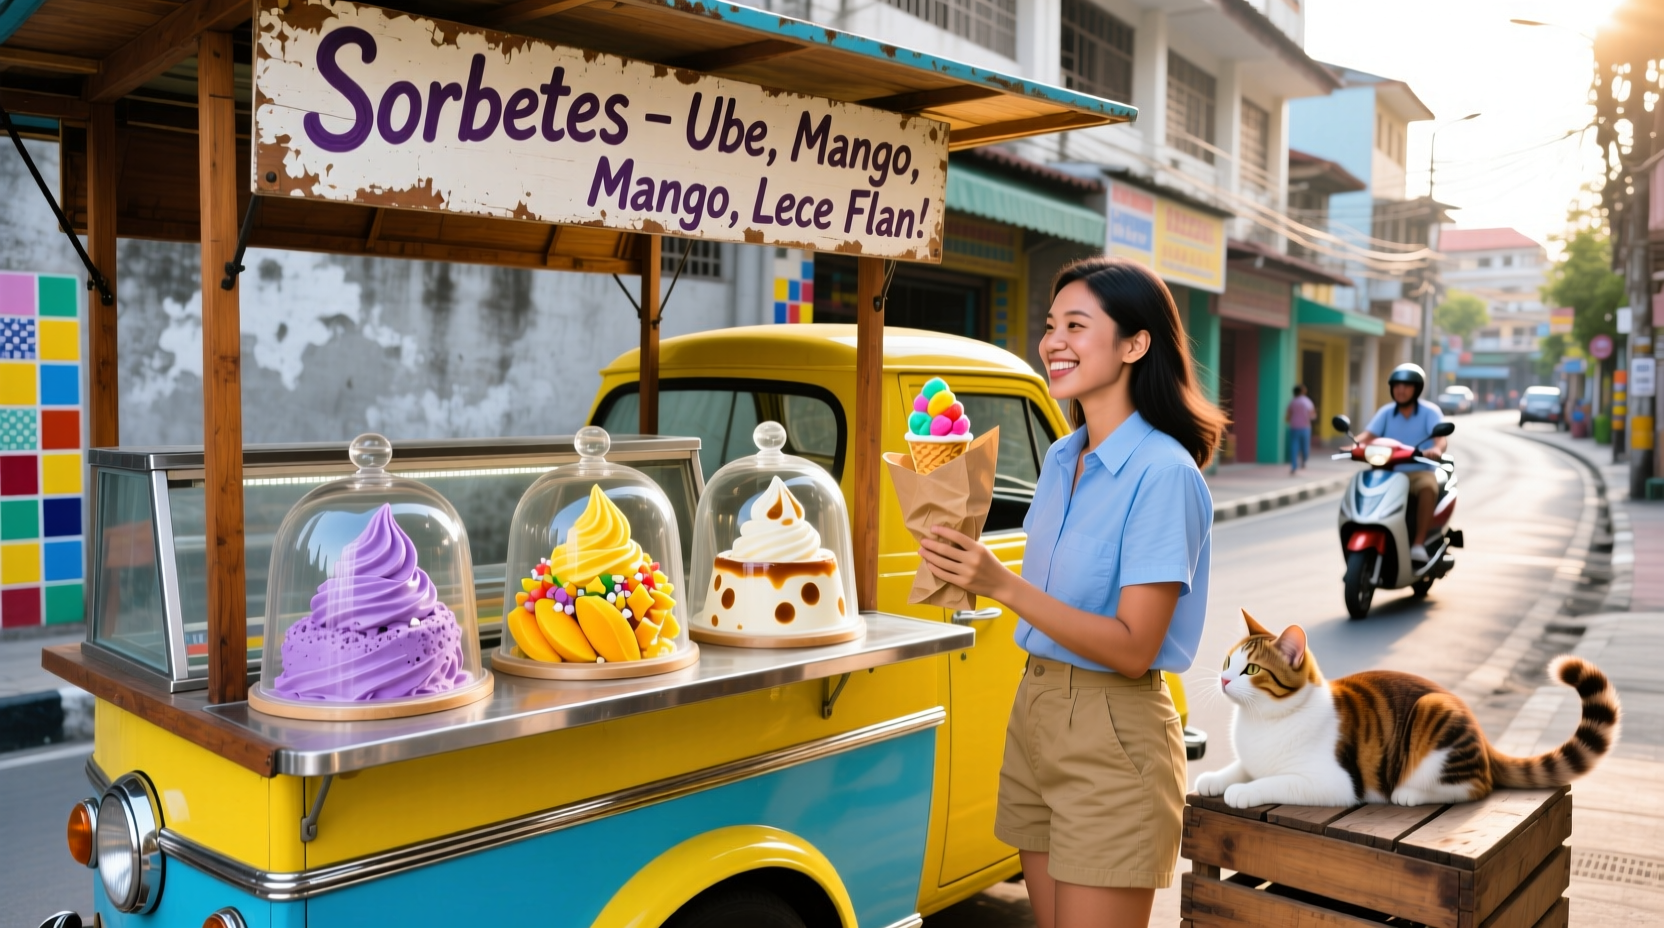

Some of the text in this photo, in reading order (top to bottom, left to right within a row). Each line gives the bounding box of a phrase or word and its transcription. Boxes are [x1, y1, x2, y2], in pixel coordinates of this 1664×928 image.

[303, 25, 630, 153] Sorbetes
[686, 91, 778, 167] Ube,
[790, 110, 920, 188] Mango,
[586, 155, 740, 232] Mango,
[752, 176, 834, 230] Lece
[843, 188, 931, 240] Flan!
